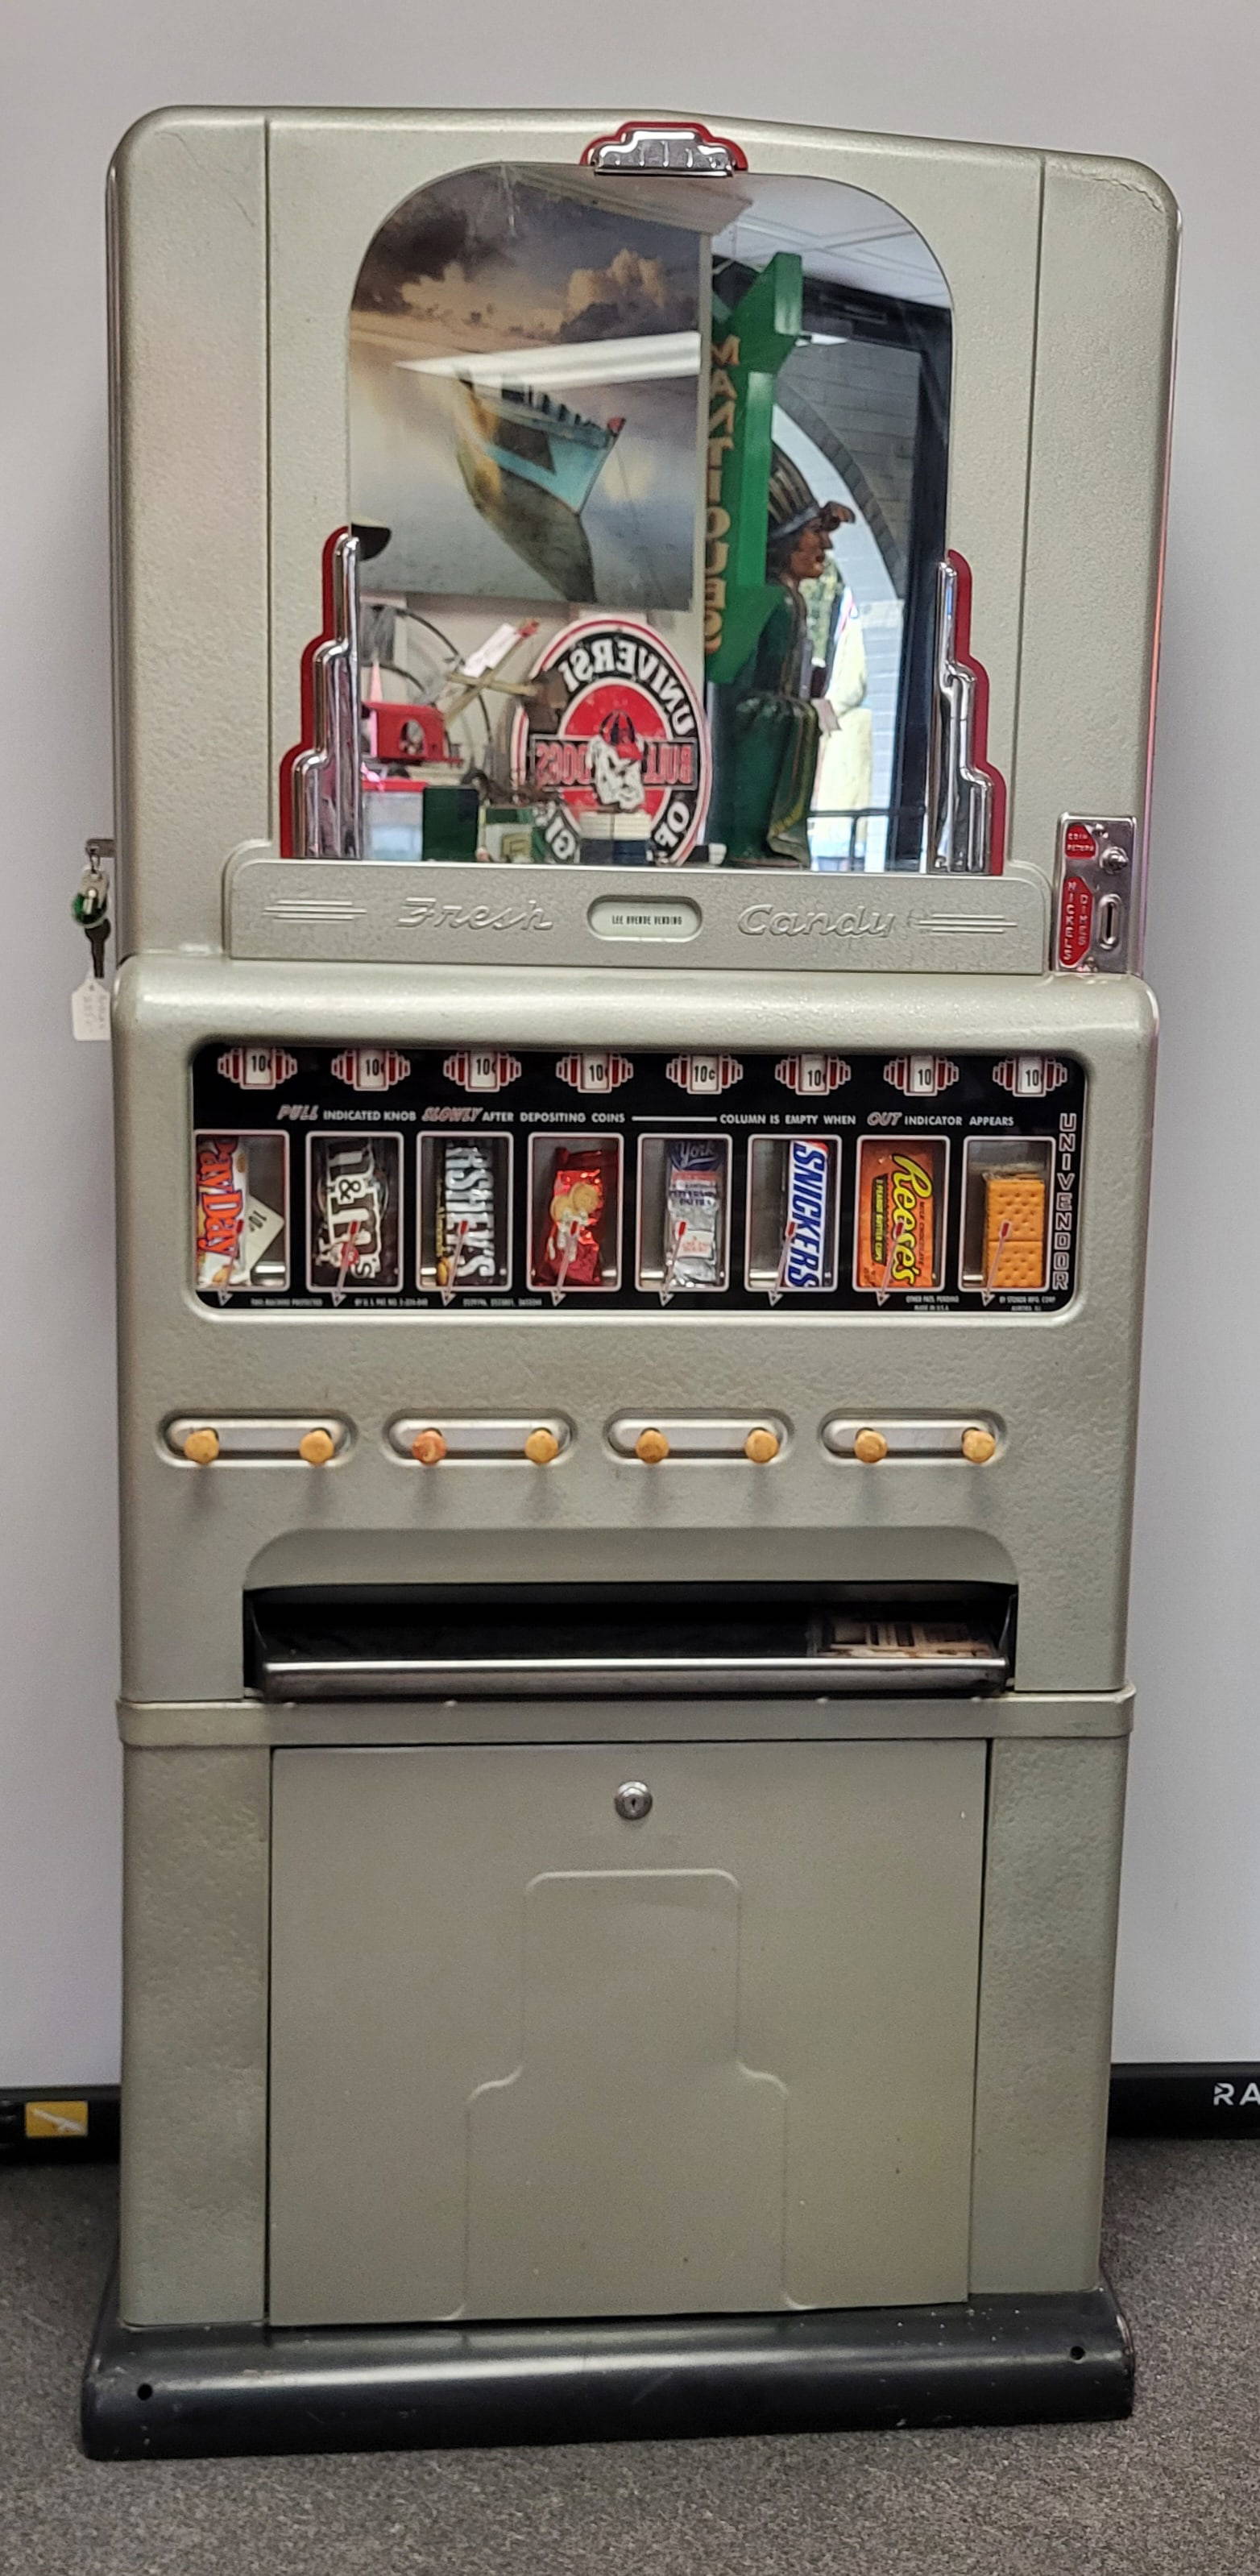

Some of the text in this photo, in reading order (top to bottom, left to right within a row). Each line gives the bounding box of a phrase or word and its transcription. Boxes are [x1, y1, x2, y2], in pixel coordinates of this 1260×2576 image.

[397, 896, 553, 931] Fresh
[737, 903, 897, 938] Candy
[1063, 881, 1077, 960] NICKELS
[1078, 894, 1088, 946] DIMES
[276, 1104, 1014, 1126] PULL INDICATED KNOB SLOWLY AFTER DEPOSITING COINS COLUMN IS EMPTY WHEN OUT INDICATOR APPEARS
[787, 1142, 826, 1287] SNICKERS
[1052, 1112, 1077, 1290] UNIVENDOR
